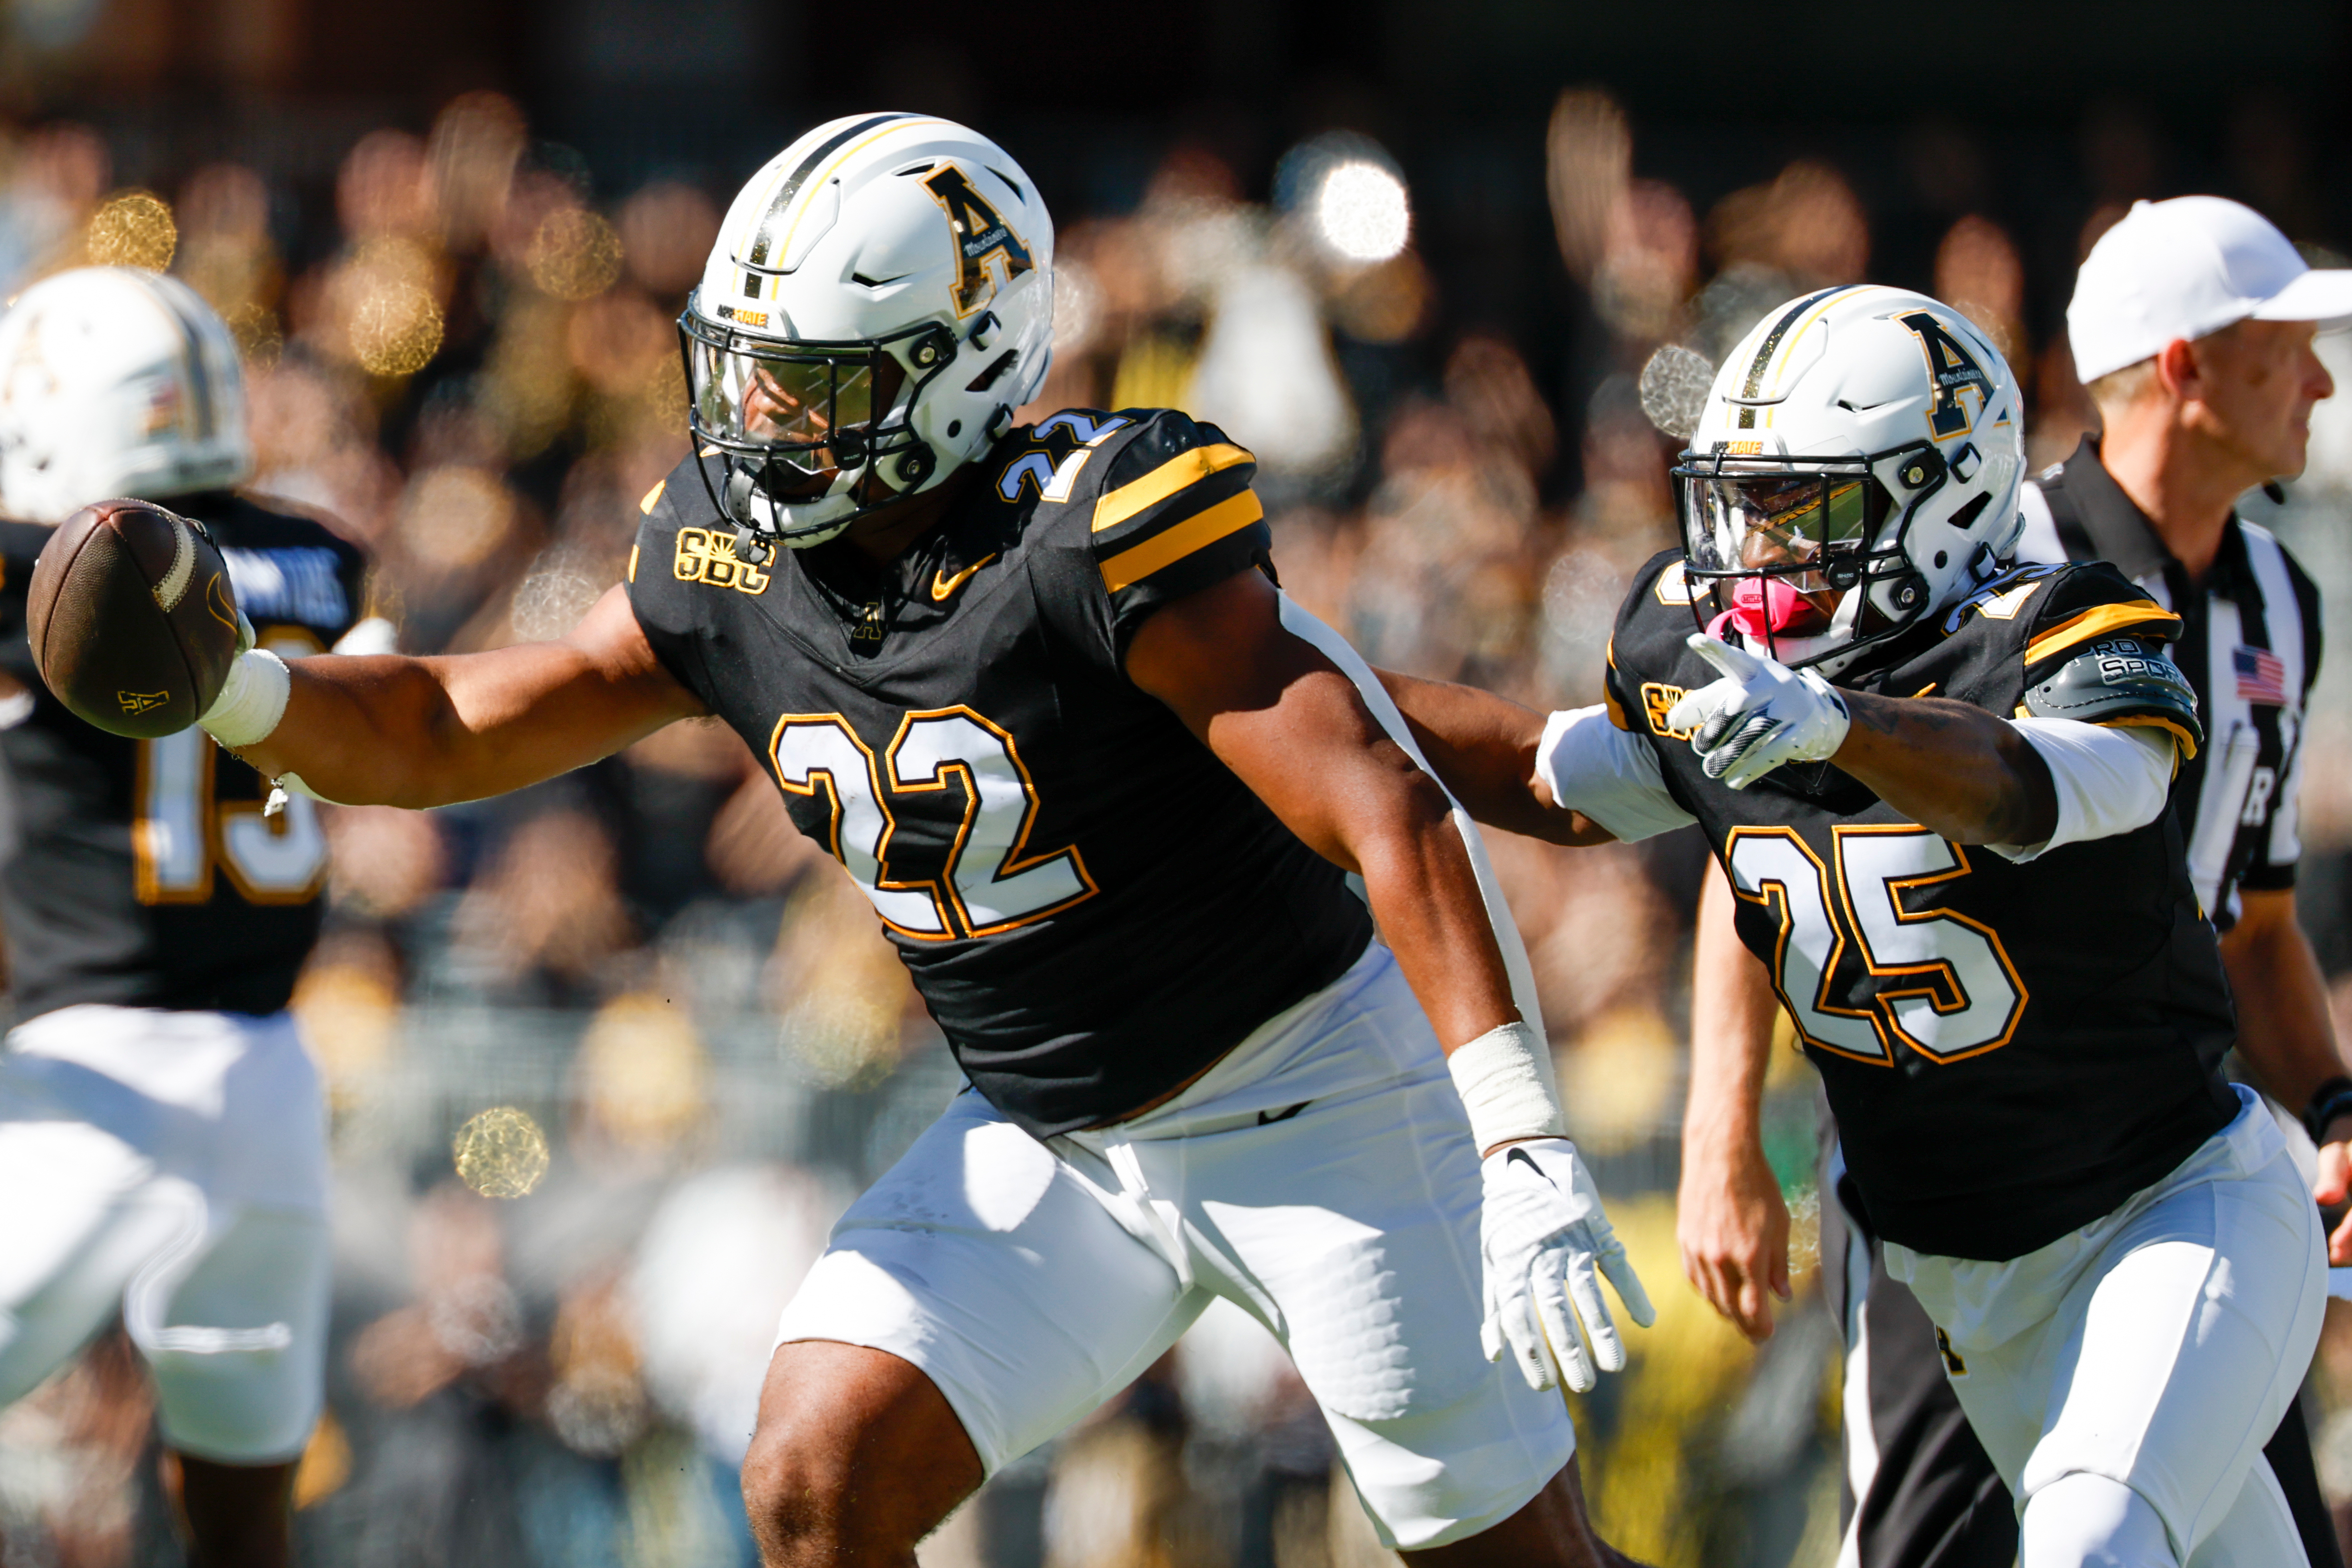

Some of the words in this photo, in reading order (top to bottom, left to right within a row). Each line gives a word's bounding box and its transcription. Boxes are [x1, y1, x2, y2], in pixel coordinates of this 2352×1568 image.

[995, 412, 1137, 504] 22
[853, 602, 882, 640] A
[769, 704, 1100, 941] 22
[2240, 765, 2276, 827] R
[1725, 823, 2029, 1067] 25
